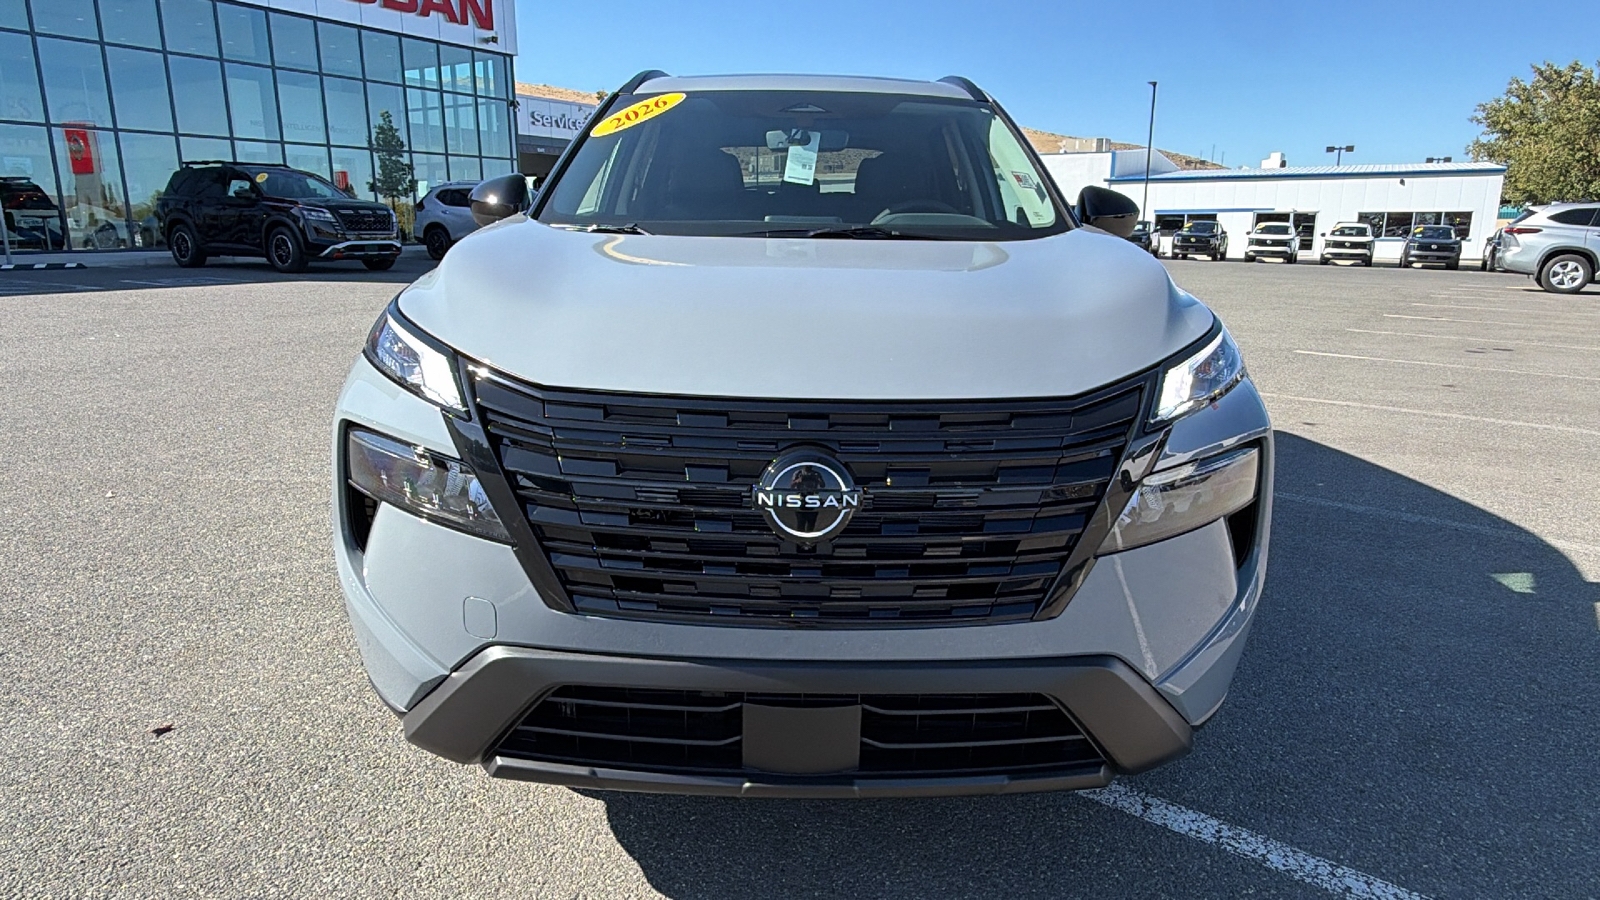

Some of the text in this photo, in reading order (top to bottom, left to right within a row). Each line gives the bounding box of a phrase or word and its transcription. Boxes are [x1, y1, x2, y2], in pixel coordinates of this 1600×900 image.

[530, 110, 585, 131] Service
[609, 97, 668, 129] 2026
[757, 492, 858, 508] NISSAN
